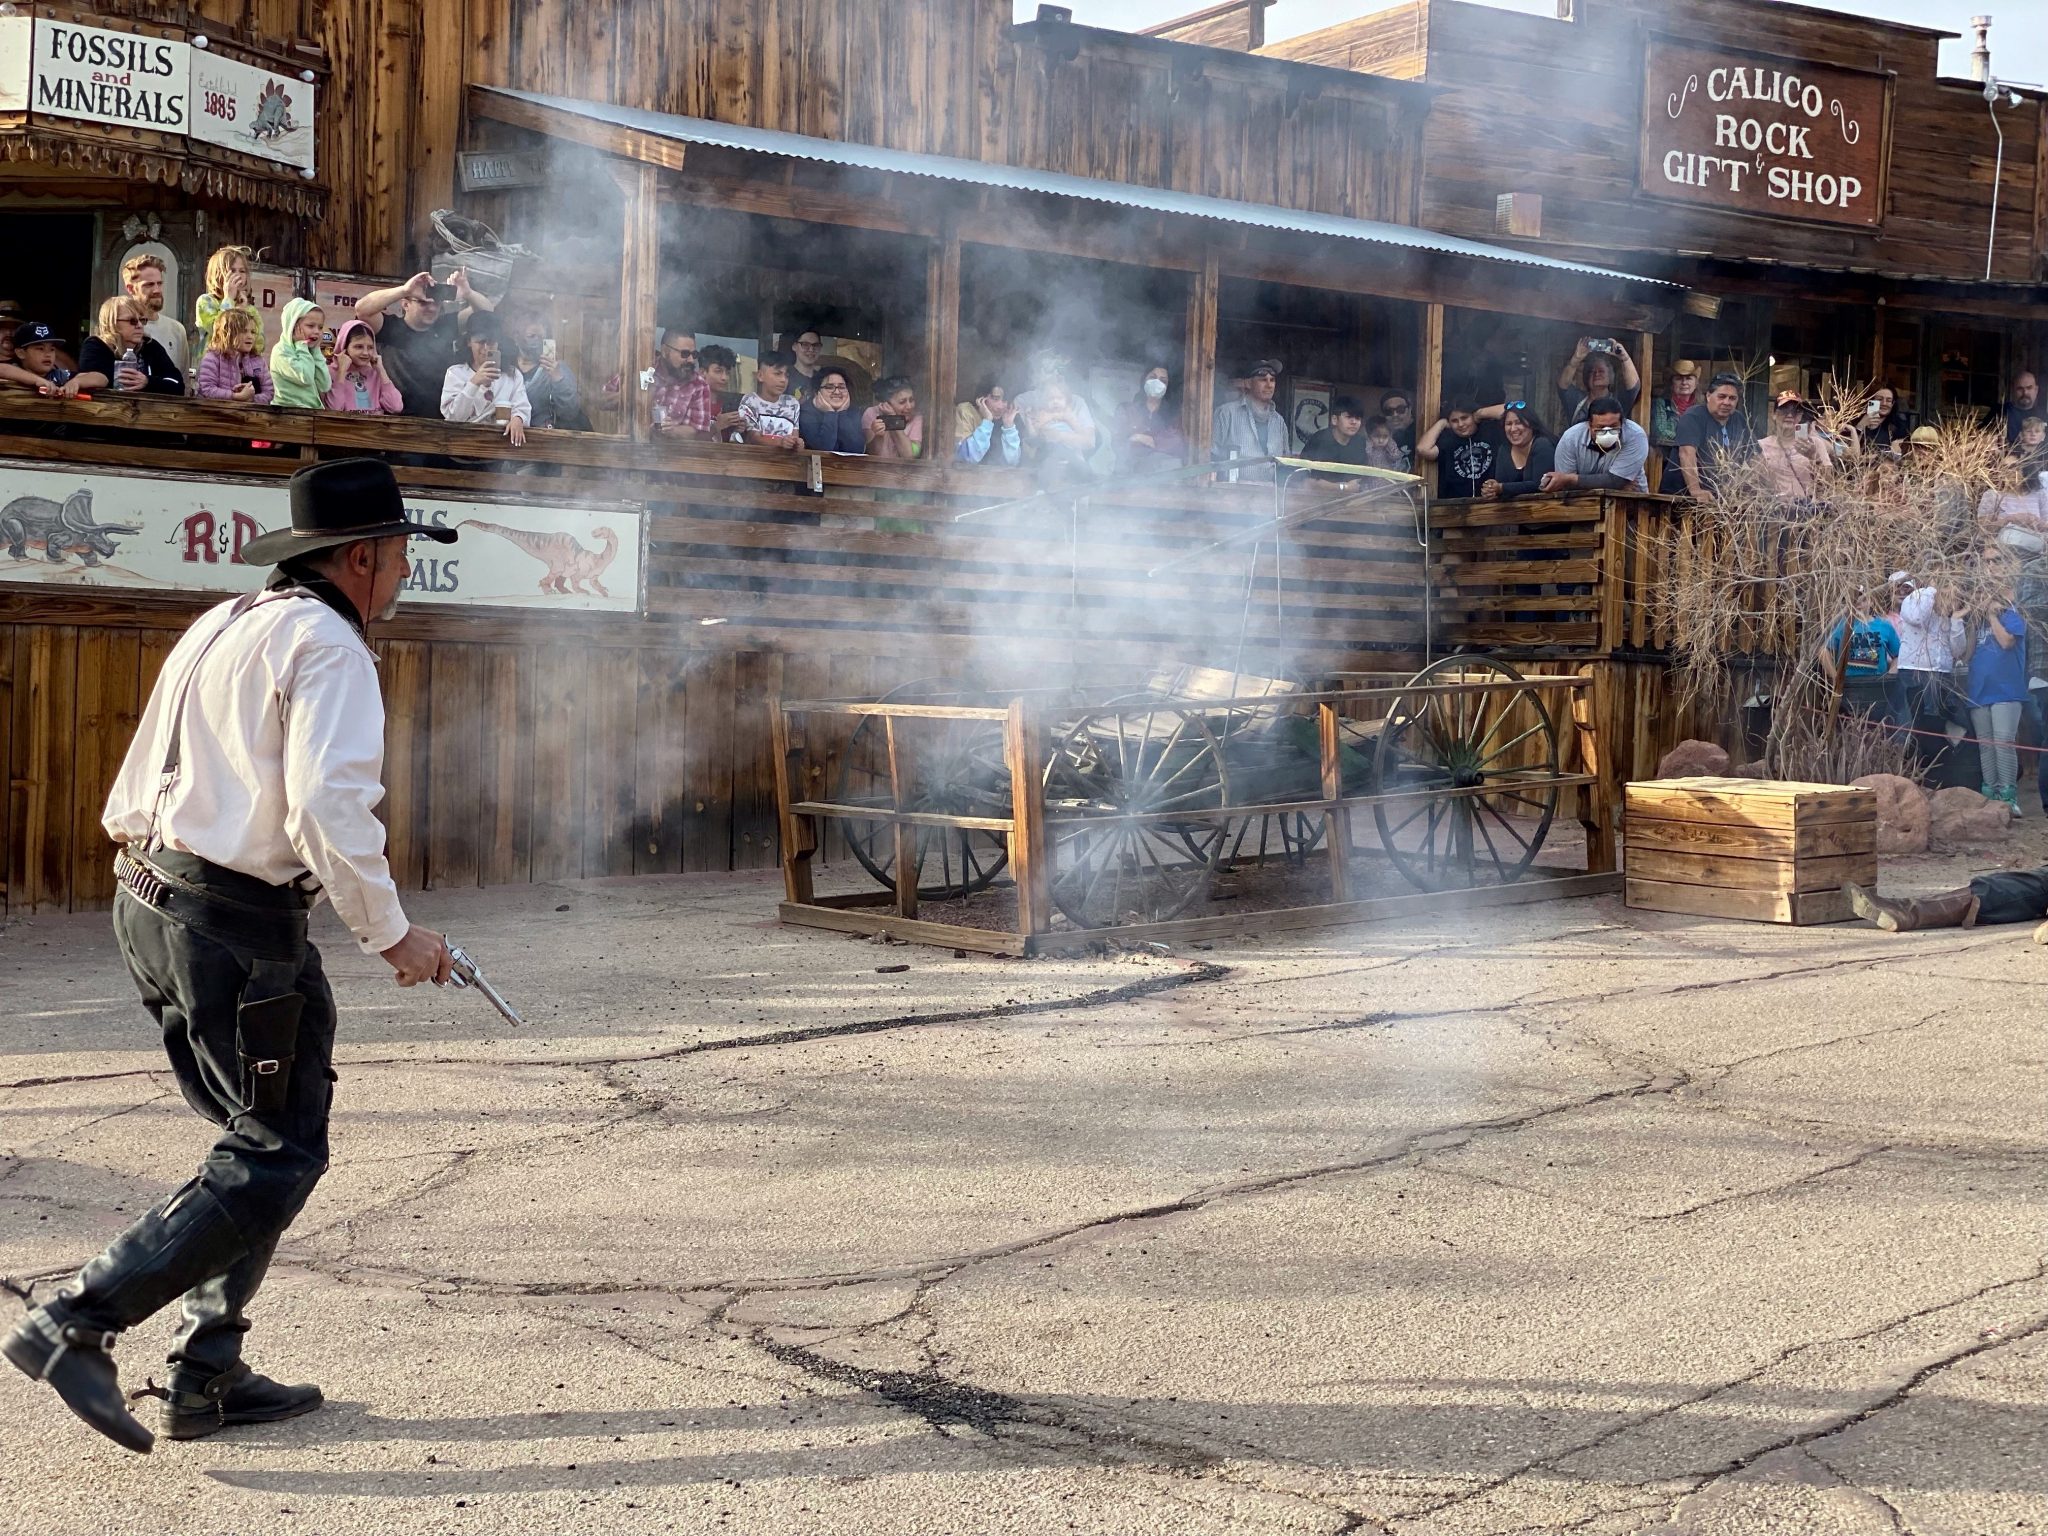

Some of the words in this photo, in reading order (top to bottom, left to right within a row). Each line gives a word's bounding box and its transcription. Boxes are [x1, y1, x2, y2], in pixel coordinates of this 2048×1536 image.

[51, 27, 173, 77] FOSSILS
[38, 74, 184, 126] MINERALS
[91, 71, 131, 87] and
[1707, 67, 1823, 117] CALICO
[204, 91, 236, 121] 1885
[1715, 114, 1814, 159] ROCK
[1663, 150, 1749, 192] GIFT
[1767, 166, 1861, 208] SHOP
[263, 289, 275, 308] D
[334, 295, 357, 306] FOS
[183, 510, 219, 564] R
[219, 522, 229, 553] &
[230, 510, 258, 565] D
